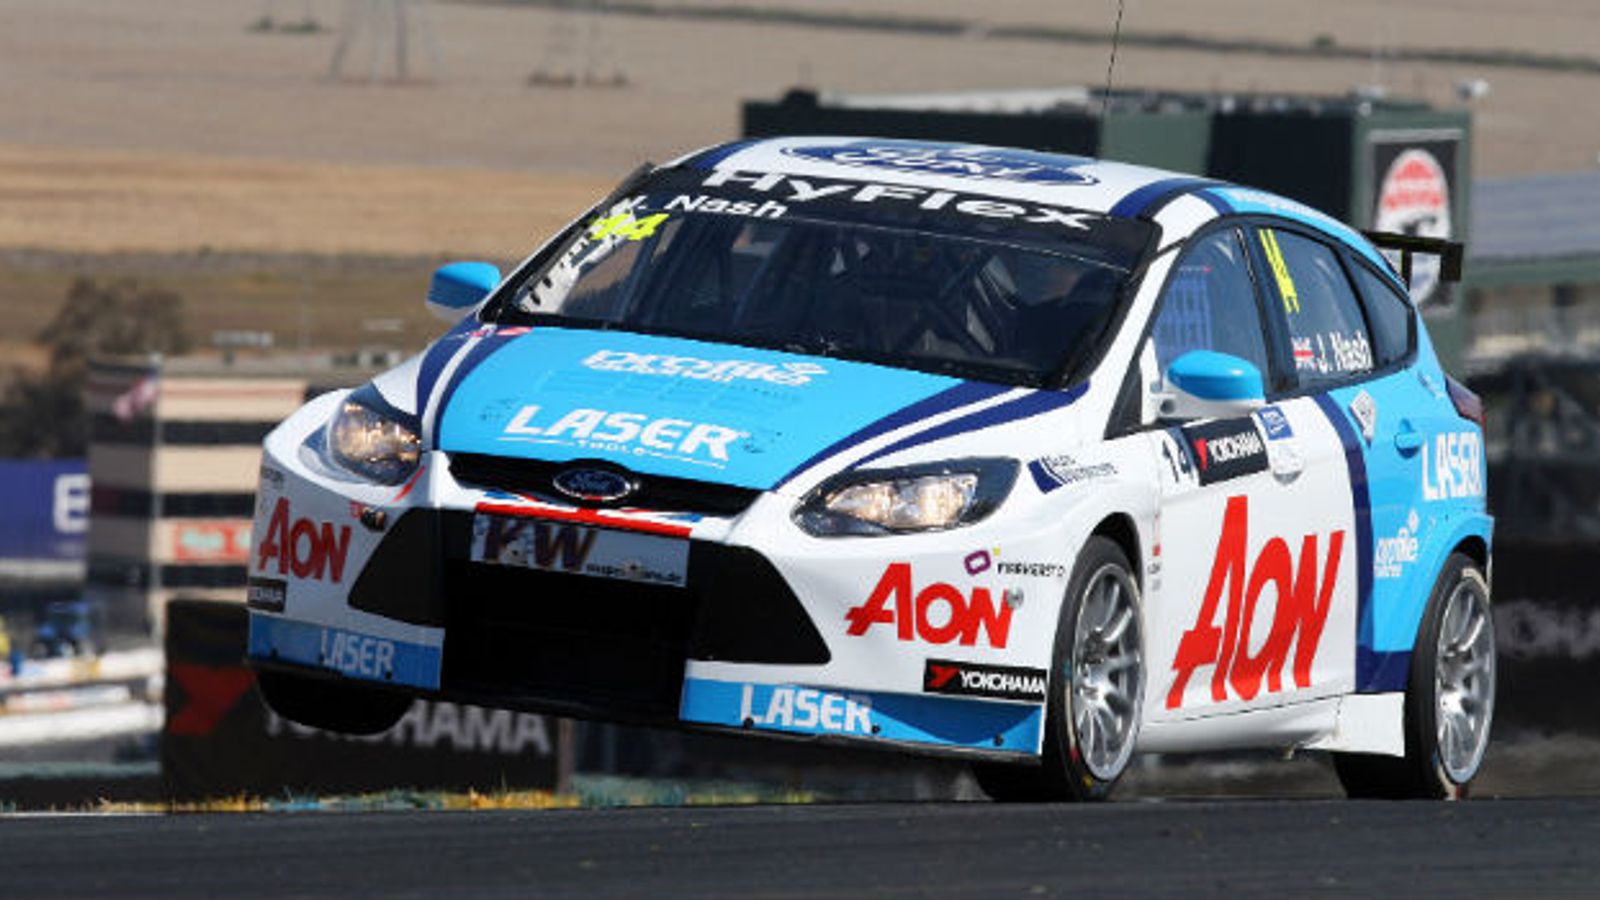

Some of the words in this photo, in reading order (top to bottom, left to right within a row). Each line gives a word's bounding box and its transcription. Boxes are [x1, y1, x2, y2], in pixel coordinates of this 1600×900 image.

[663, 194, 788, 219] Nash
[1329, 329, 1374, 372] Nash
[503, 405, 739, 461] LASER
[1206, 432, 1264, 463] YOKOHAMA
[320, 628, 395, 680] LASER
[961, 671, 1046, 695] YOKOHAMA
[740, 684, 873, 734] LASER
